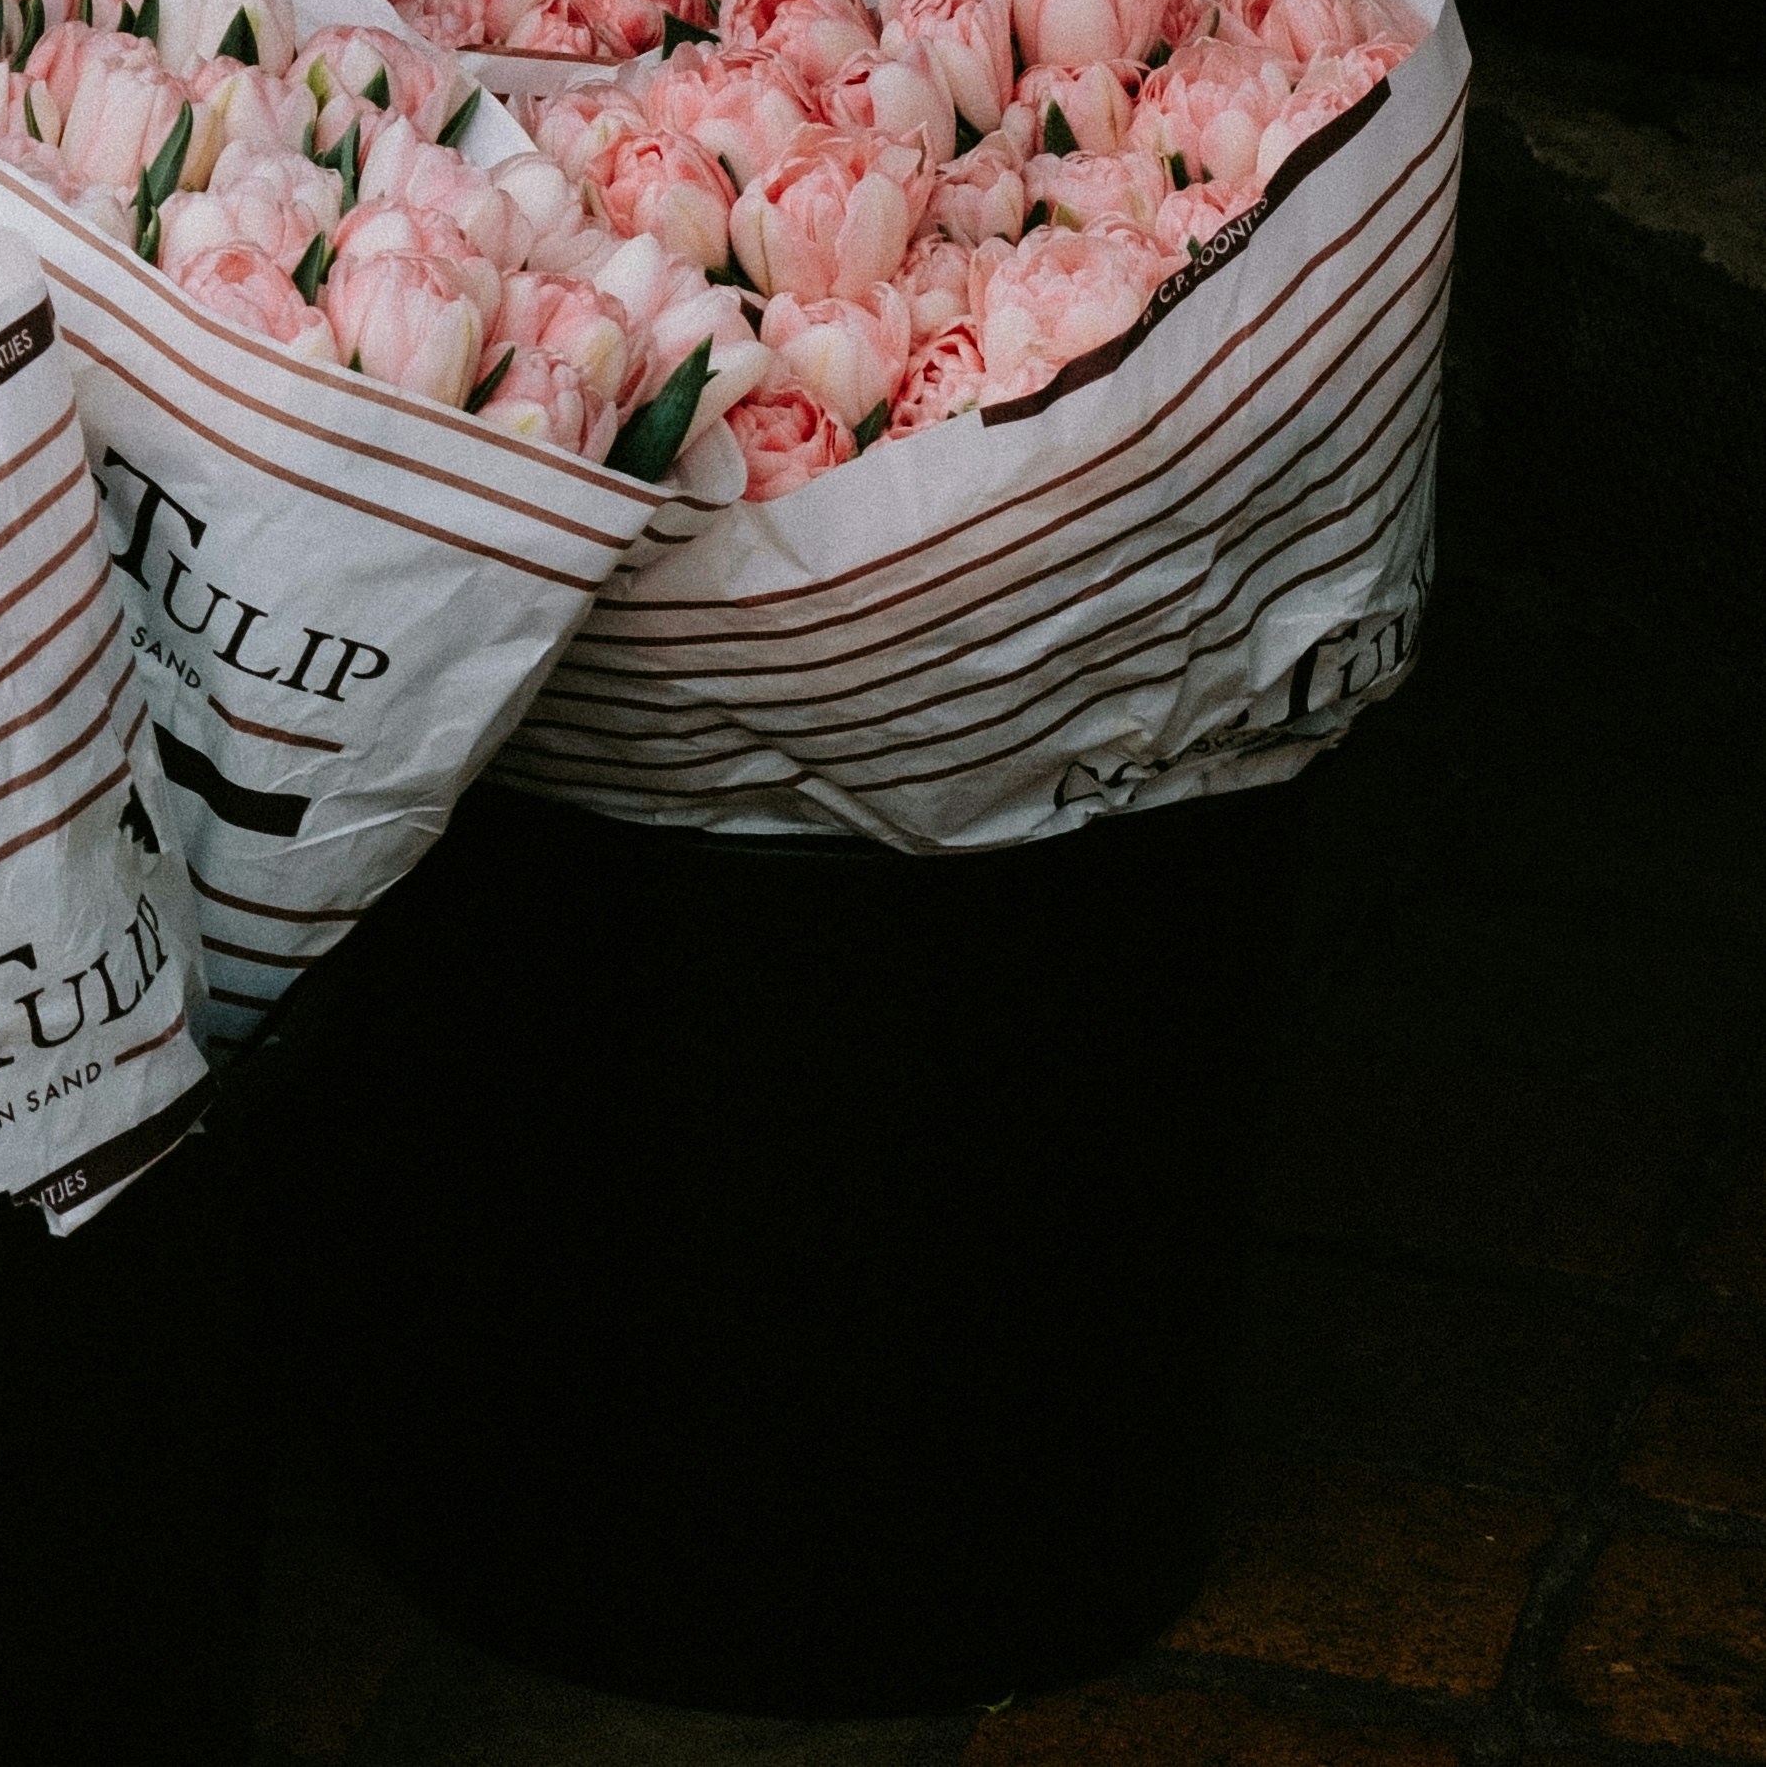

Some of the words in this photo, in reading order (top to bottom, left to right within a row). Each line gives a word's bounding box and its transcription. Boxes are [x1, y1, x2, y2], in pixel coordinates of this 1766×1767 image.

[93, 445, 391, 703] TULIP
[130, 625, 203, 690] SAND
[25, 1061, 102, 1113] SAND
